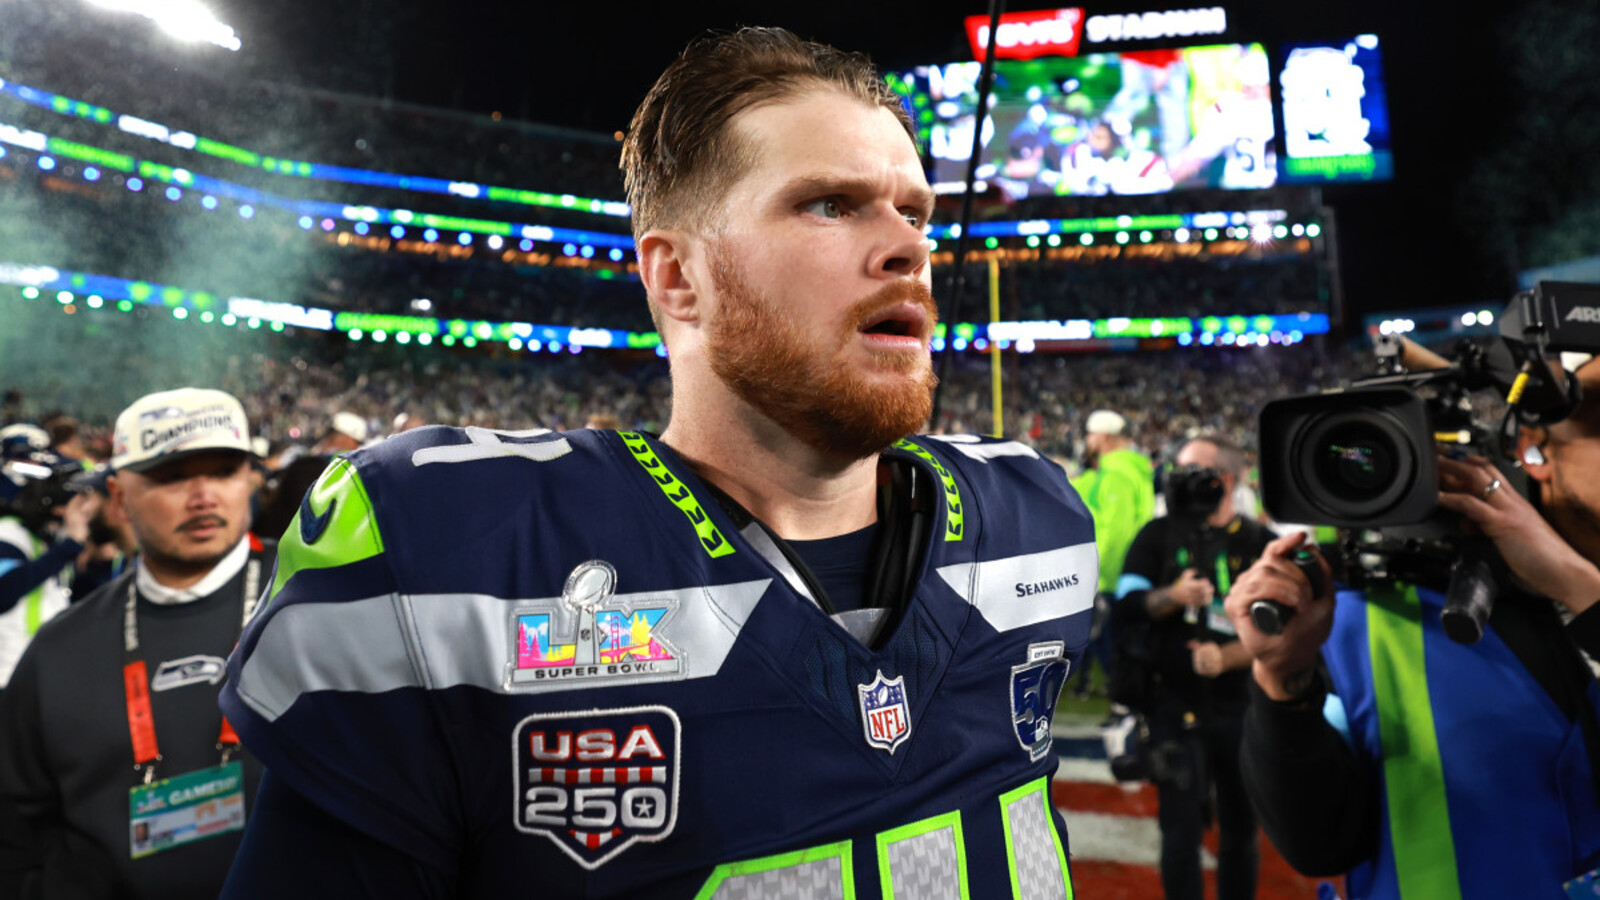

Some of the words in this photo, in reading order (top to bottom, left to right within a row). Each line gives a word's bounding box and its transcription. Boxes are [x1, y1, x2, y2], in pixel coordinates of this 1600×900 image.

[1015, 573, 1080, 598] SEAHAWKS
[534, 668, 599, 680] SUPER
[607, 662, 657, 676] BOWL
[870, 707, 906, 740] NFL
[529, 724, 666, 763] USA
[525, 786, 667, 829] 250
